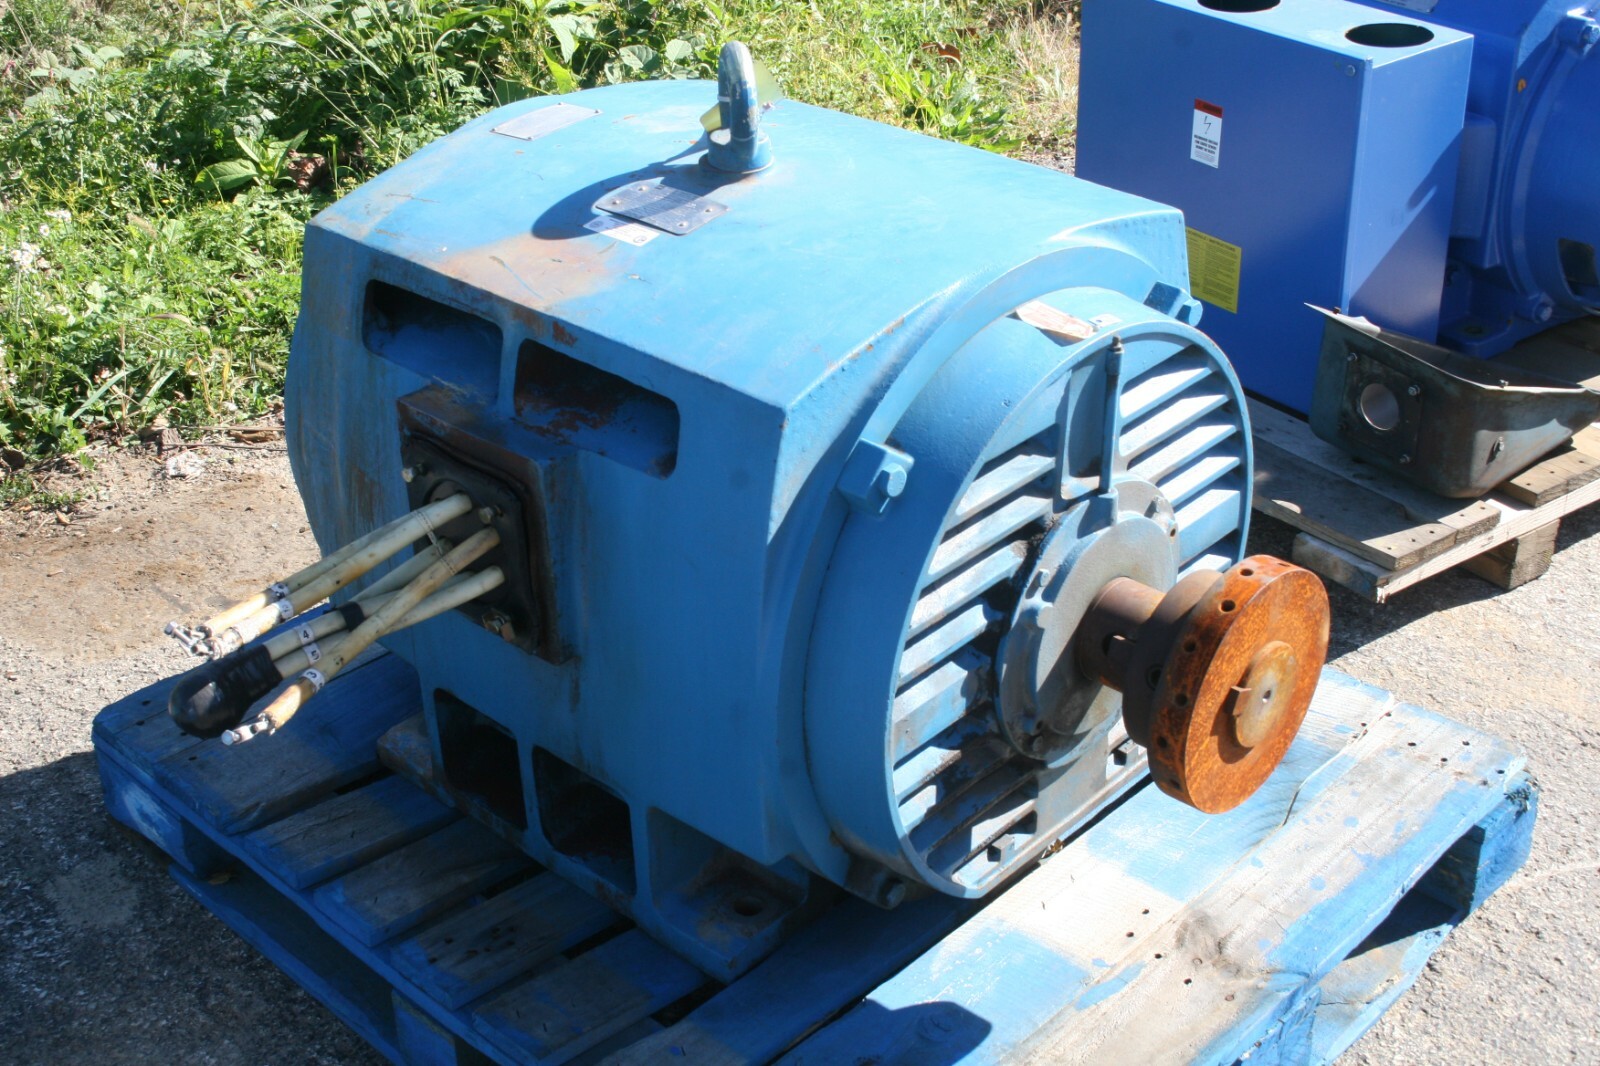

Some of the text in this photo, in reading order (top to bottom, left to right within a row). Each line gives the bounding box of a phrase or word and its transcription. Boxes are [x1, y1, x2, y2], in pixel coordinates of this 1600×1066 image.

[303, 630, 310, 639] 4
[311, 650, 320, 660] 5
[307, 671, 317, 679] 3
